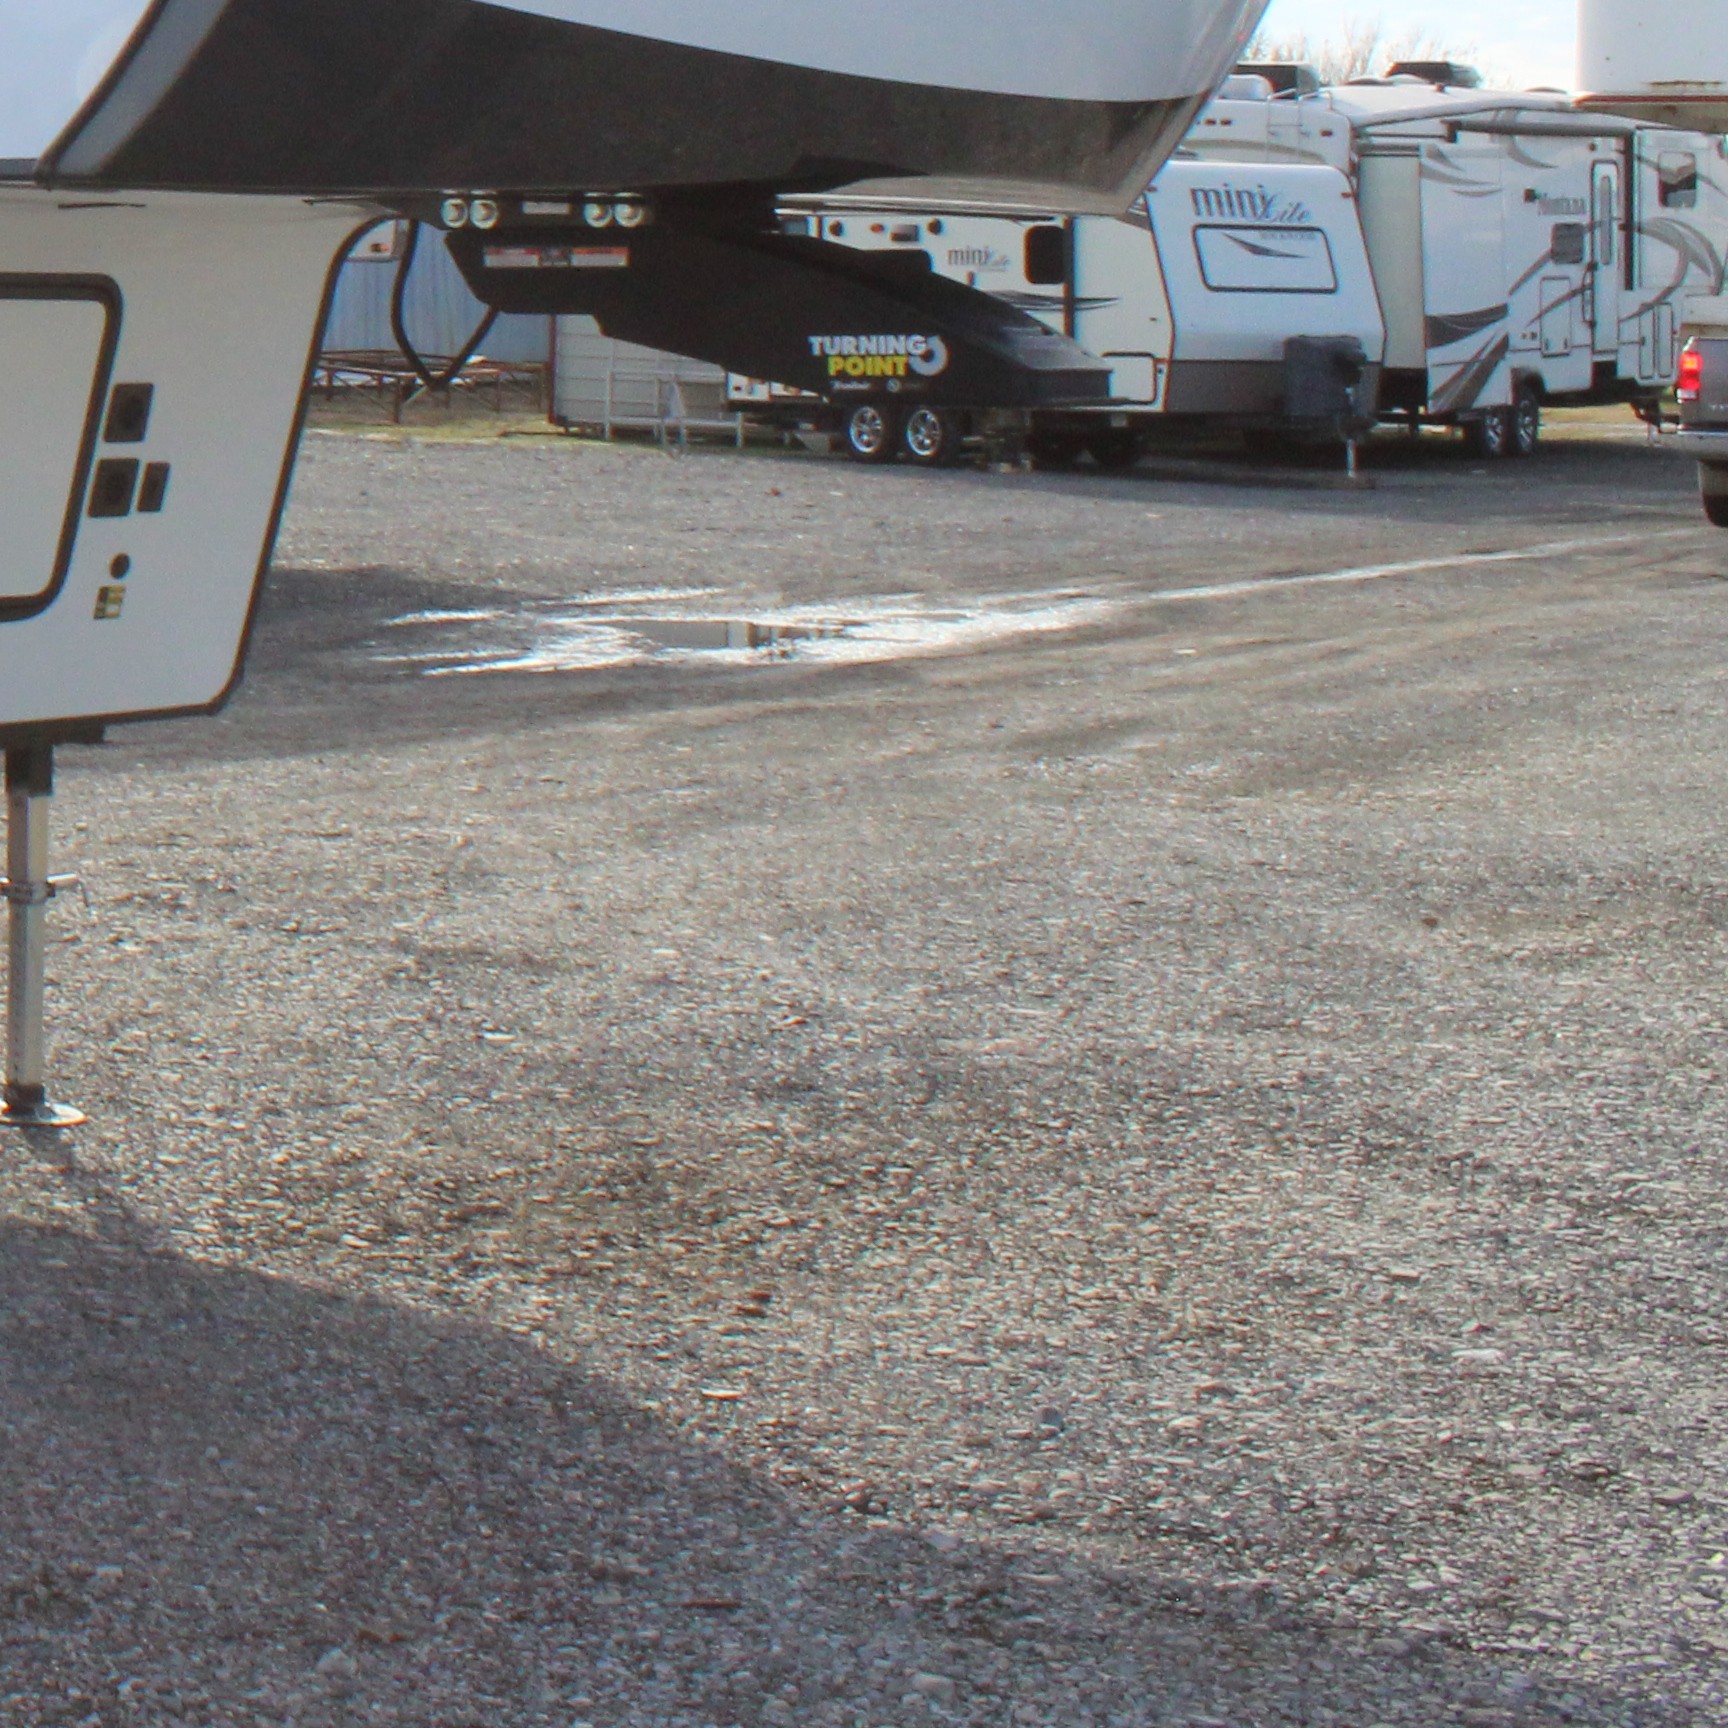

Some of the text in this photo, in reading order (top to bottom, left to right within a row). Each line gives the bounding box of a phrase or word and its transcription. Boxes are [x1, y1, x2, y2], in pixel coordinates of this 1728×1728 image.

[1190, 182, 1269, 219] mini
[808, 335, 928, 356] TURNING
[827, 356, 908, 376] POINT
